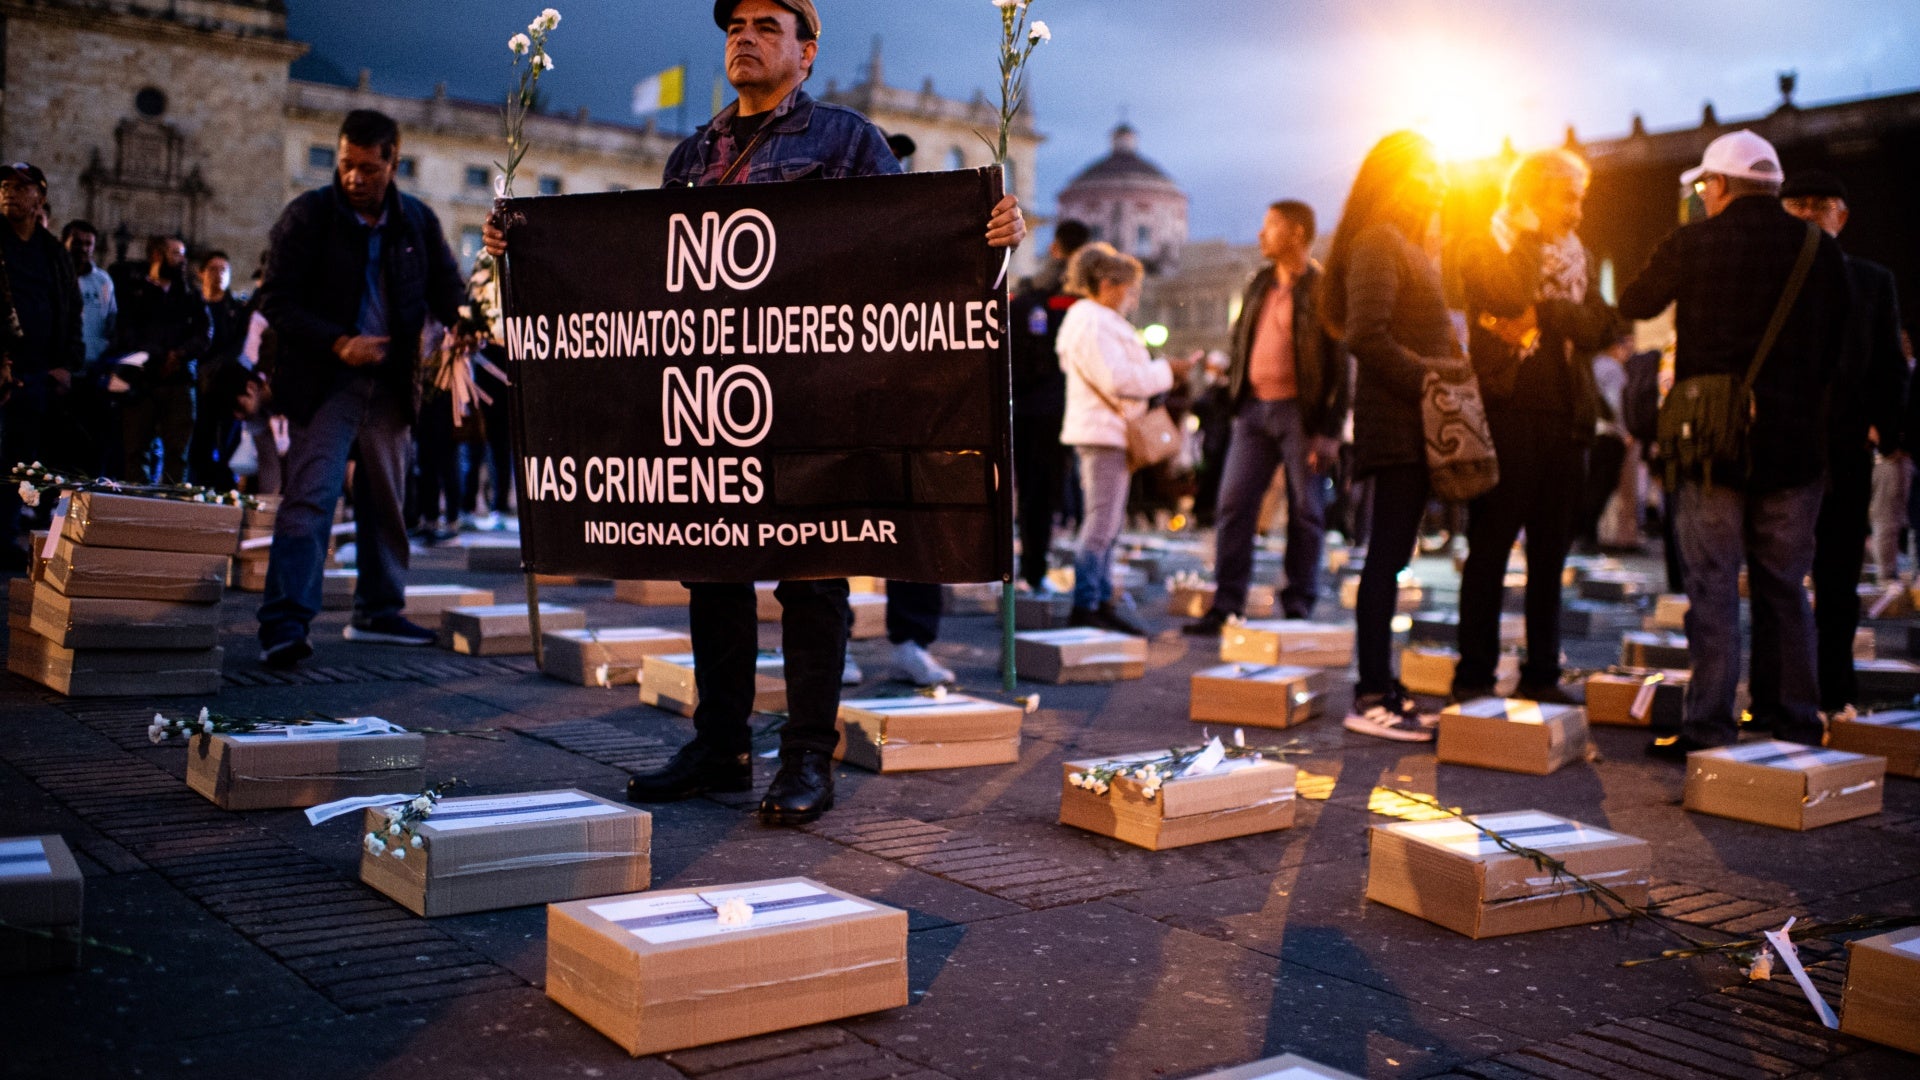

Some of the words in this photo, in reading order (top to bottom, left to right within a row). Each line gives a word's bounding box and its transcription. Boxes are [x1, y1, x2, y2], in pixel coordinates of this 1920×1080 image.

[666, 208, 777, 293] NO
[506, 314, 550, 361] MAS
[554, 308, 696, 360] ASESINATOS
[702, 307, 736, 355] DE
[742, 304, 855, 355] LIDERES
[861, 299, 999, 353] SOCIALES
[662, 364, 773, 448] NO
[584, 456, 764, 504] CRIMENES
[584, 517, 749, 547] INDIGNACIÓN
[758, 519, 898, 547] POPULAR
